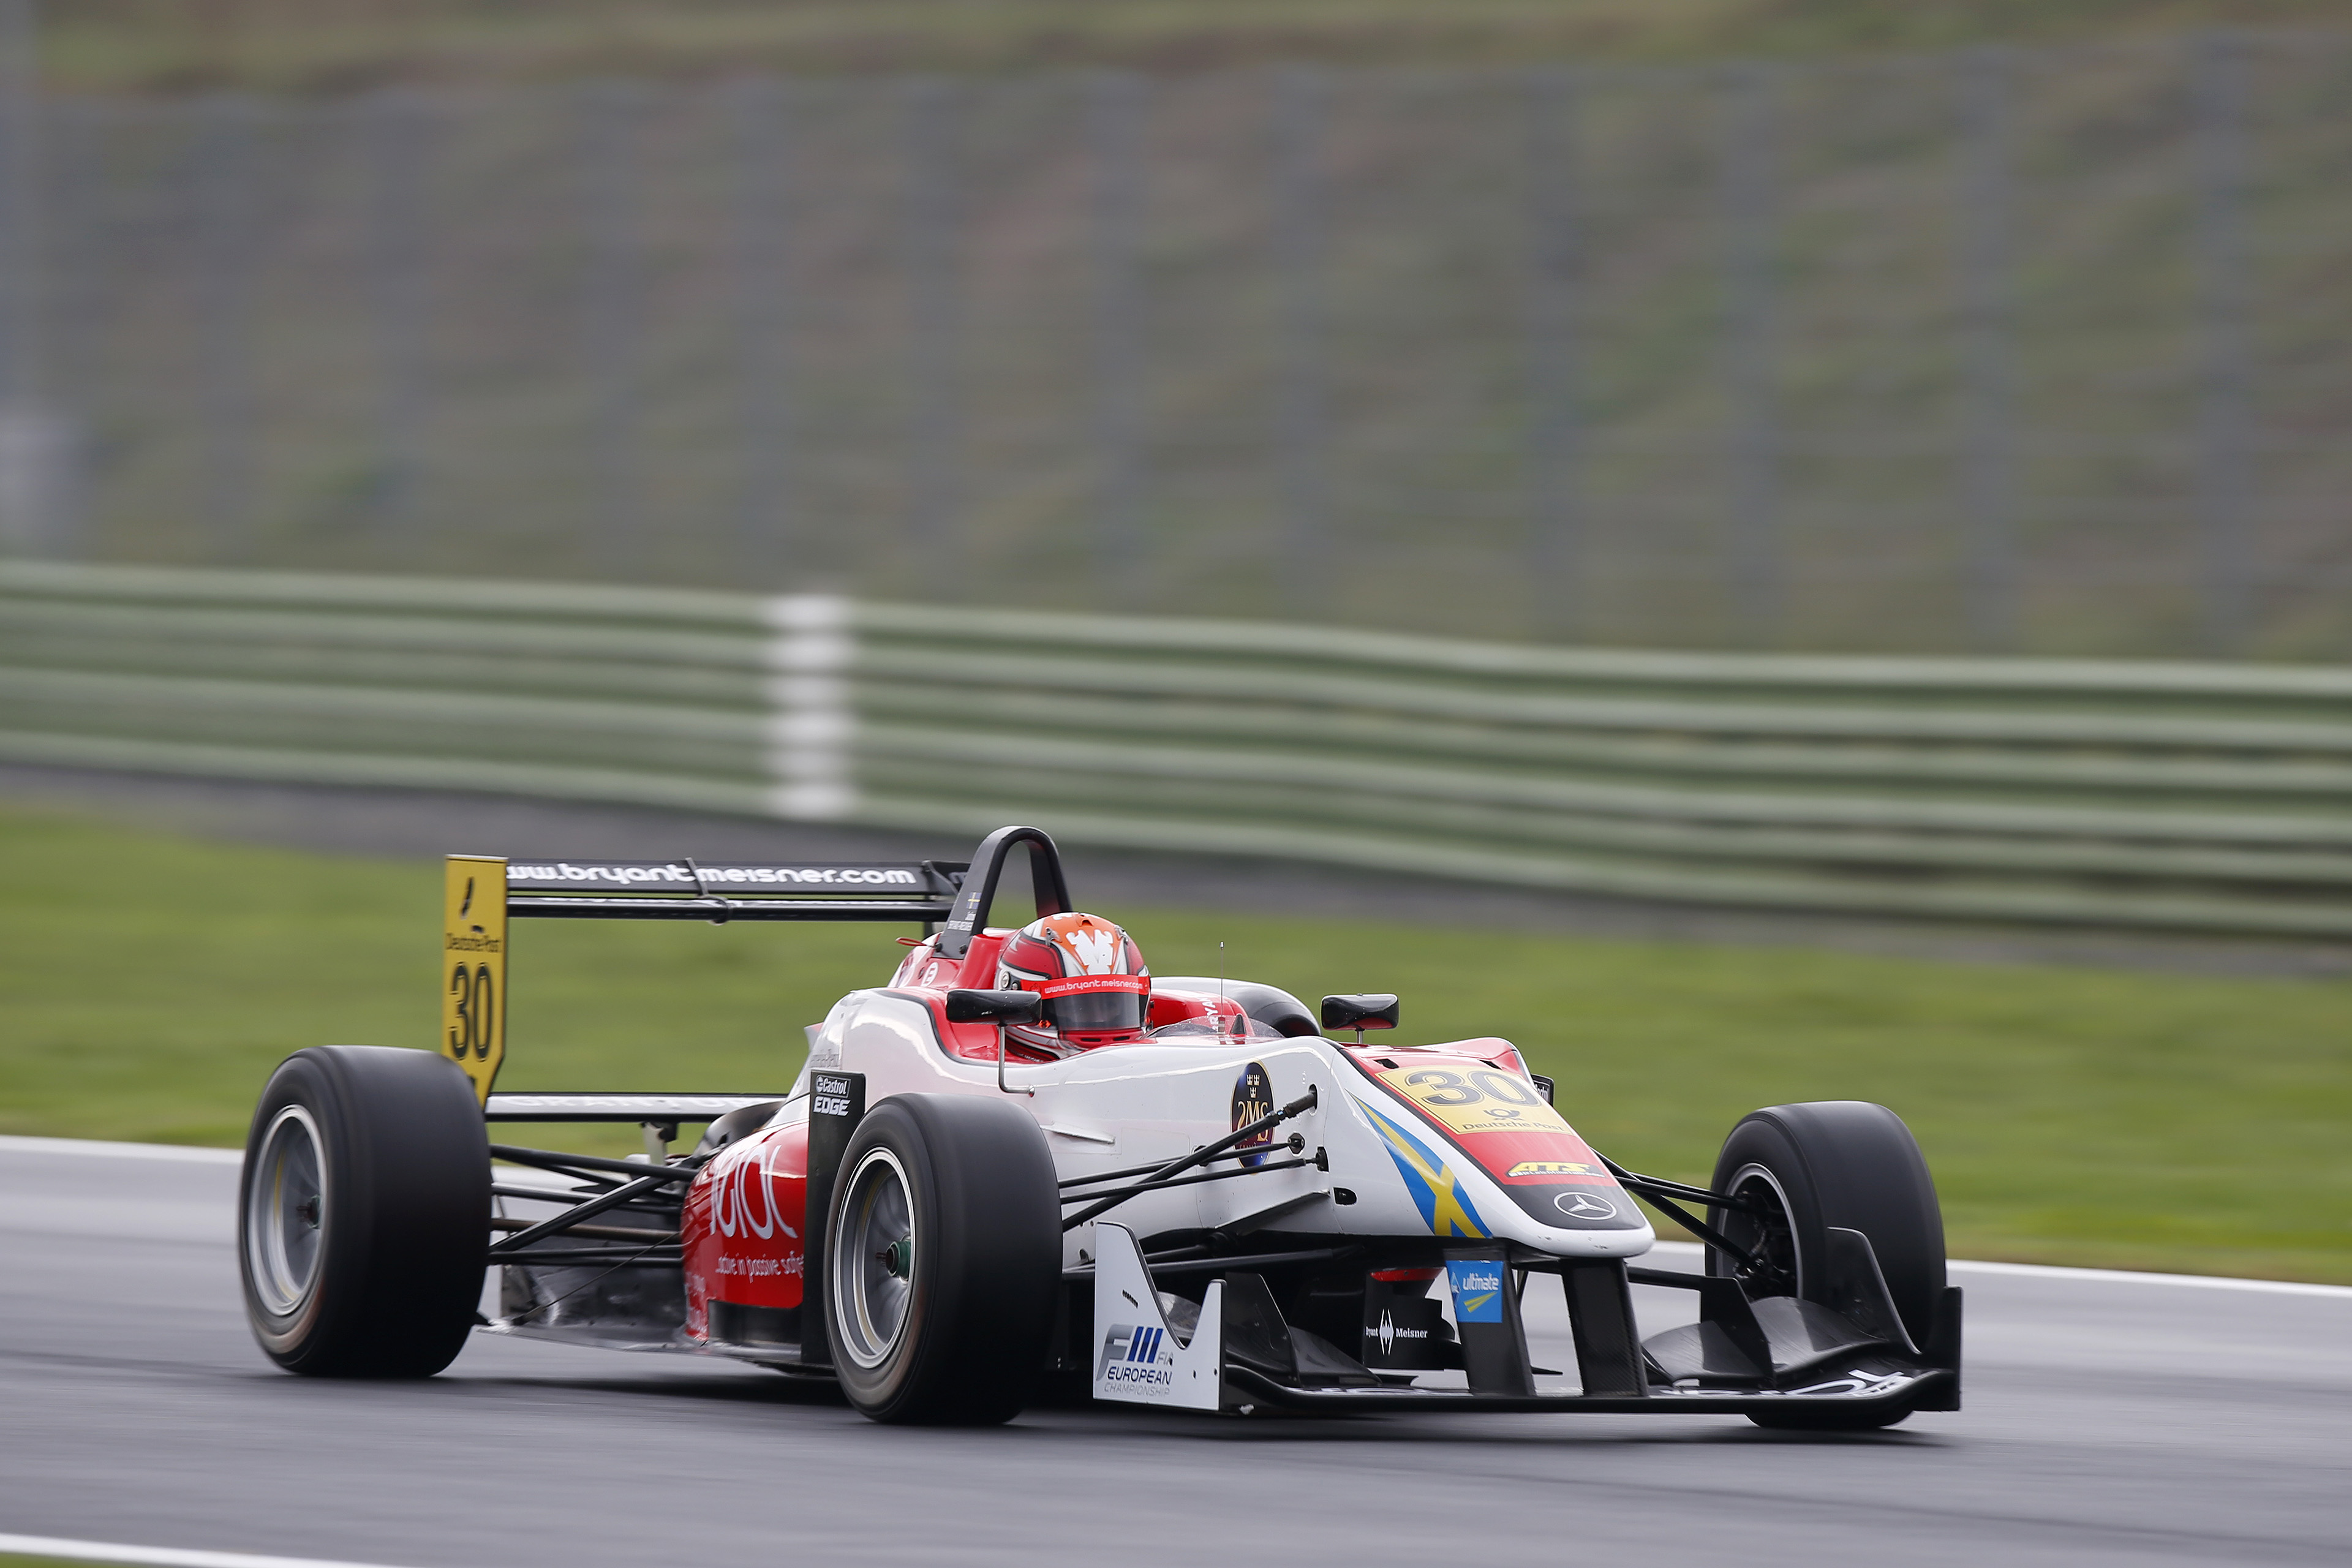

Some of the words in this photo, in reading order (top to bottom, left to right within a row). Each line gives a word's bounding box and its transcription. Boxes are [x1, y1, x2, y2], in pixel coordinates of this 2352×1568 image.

[450, 962, 493, 1061] 30
[823, 1078, 848, 1095] Castrol
[1404, 1071, 1541, 1106] 30
[813, 1096, 851, 1116] EDGE
[1462, 1121, 1531, 1130] Deutsche
[1532, 1122, 1566, 1131] Post
[1509, 1162, 1591, 1172] ATS
[1463, 1272, 1499, 1291] ultimate
[1396, 1327, 1428, 1338] Meisner
[1107, 1366, 1172, 1385] EUROPEAN
[1104, 1382, 1170, 1396] CHAMPIONSHIP
